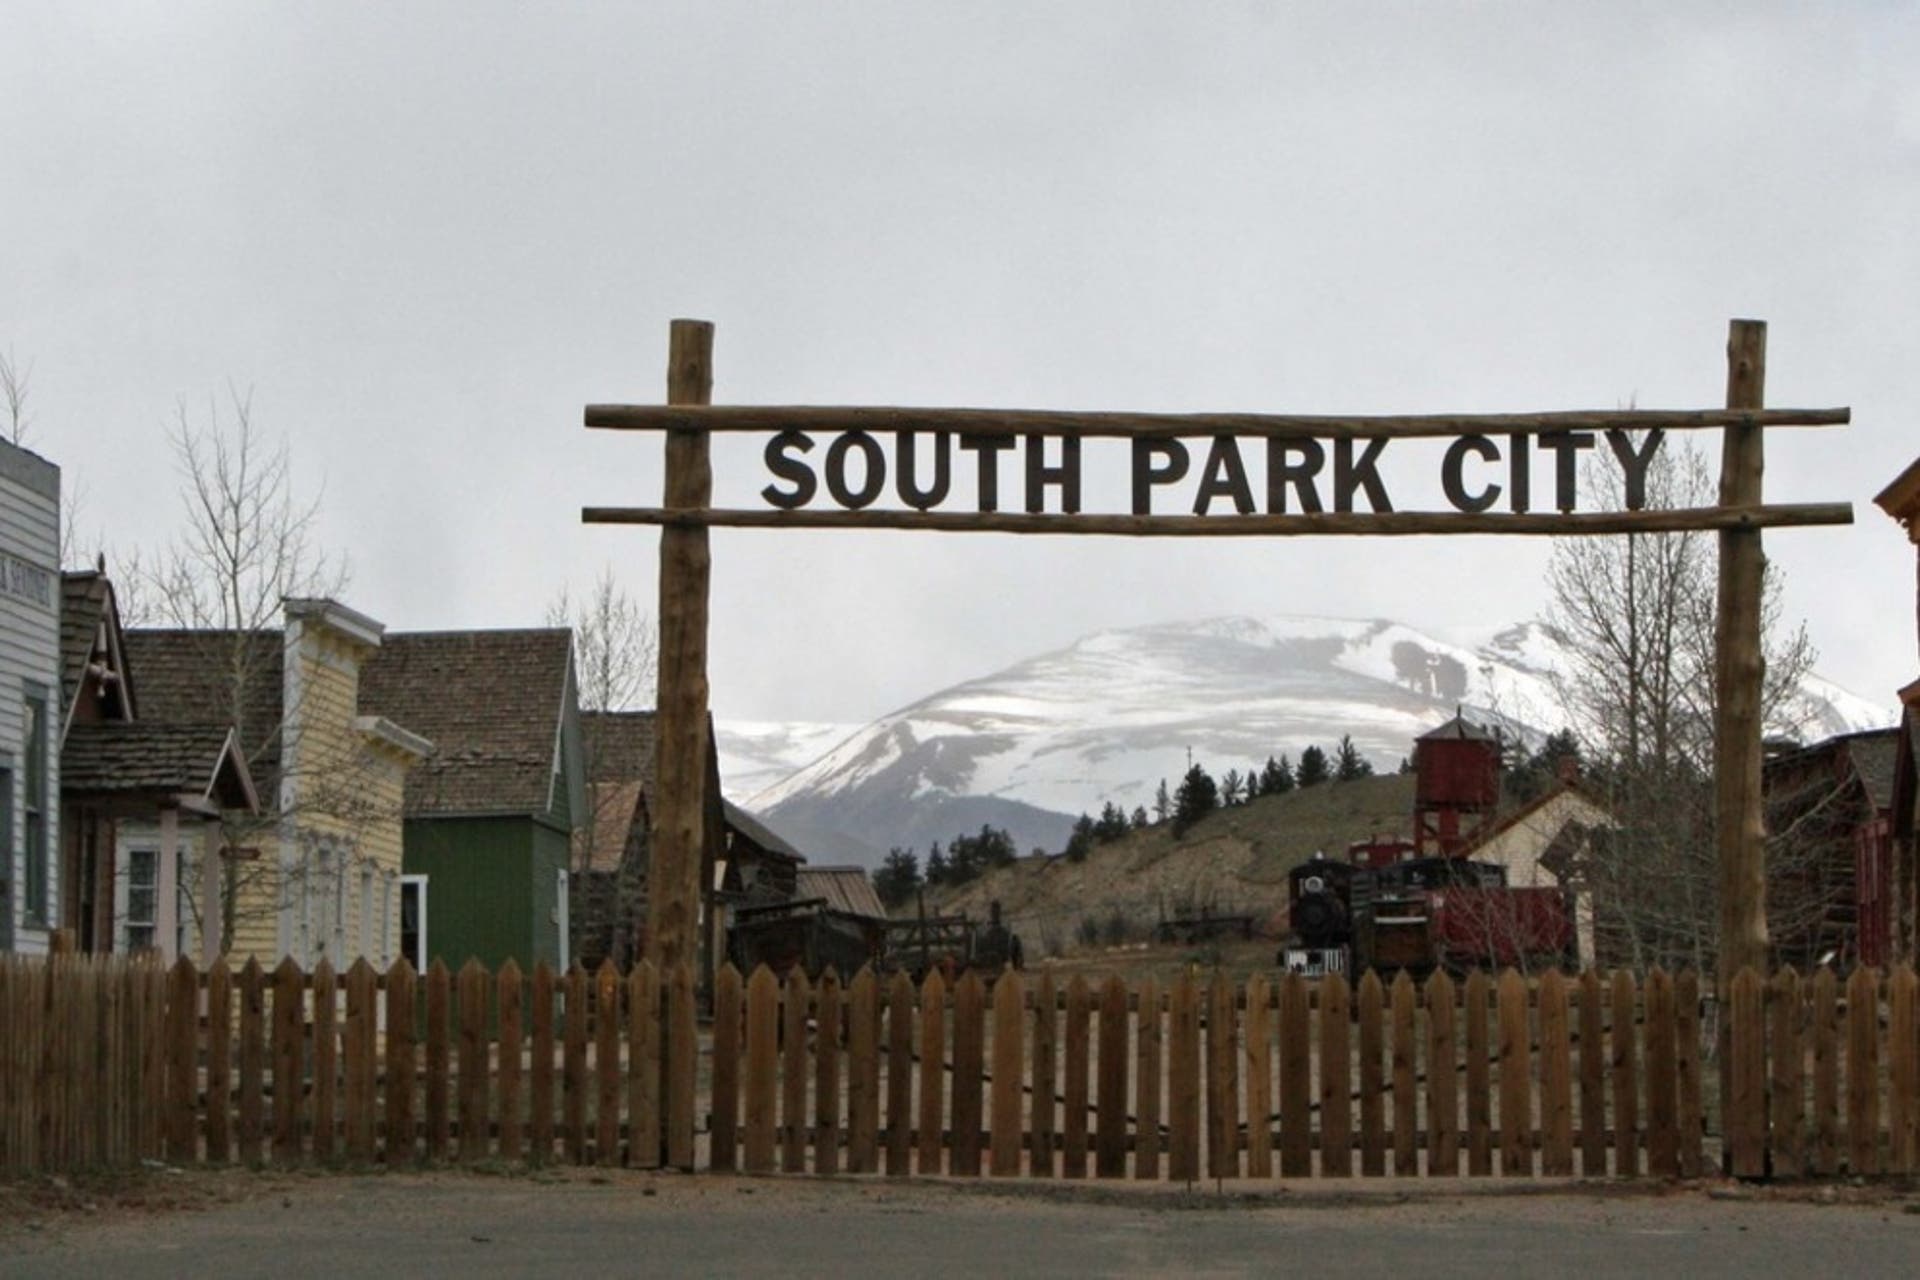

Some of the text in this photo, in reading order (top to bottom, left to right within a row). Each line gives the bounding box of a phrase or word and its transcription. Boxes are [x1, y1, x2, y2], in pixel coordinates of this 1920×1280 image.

[761, 428, 1665, 516] SOUTH PARK CITY
